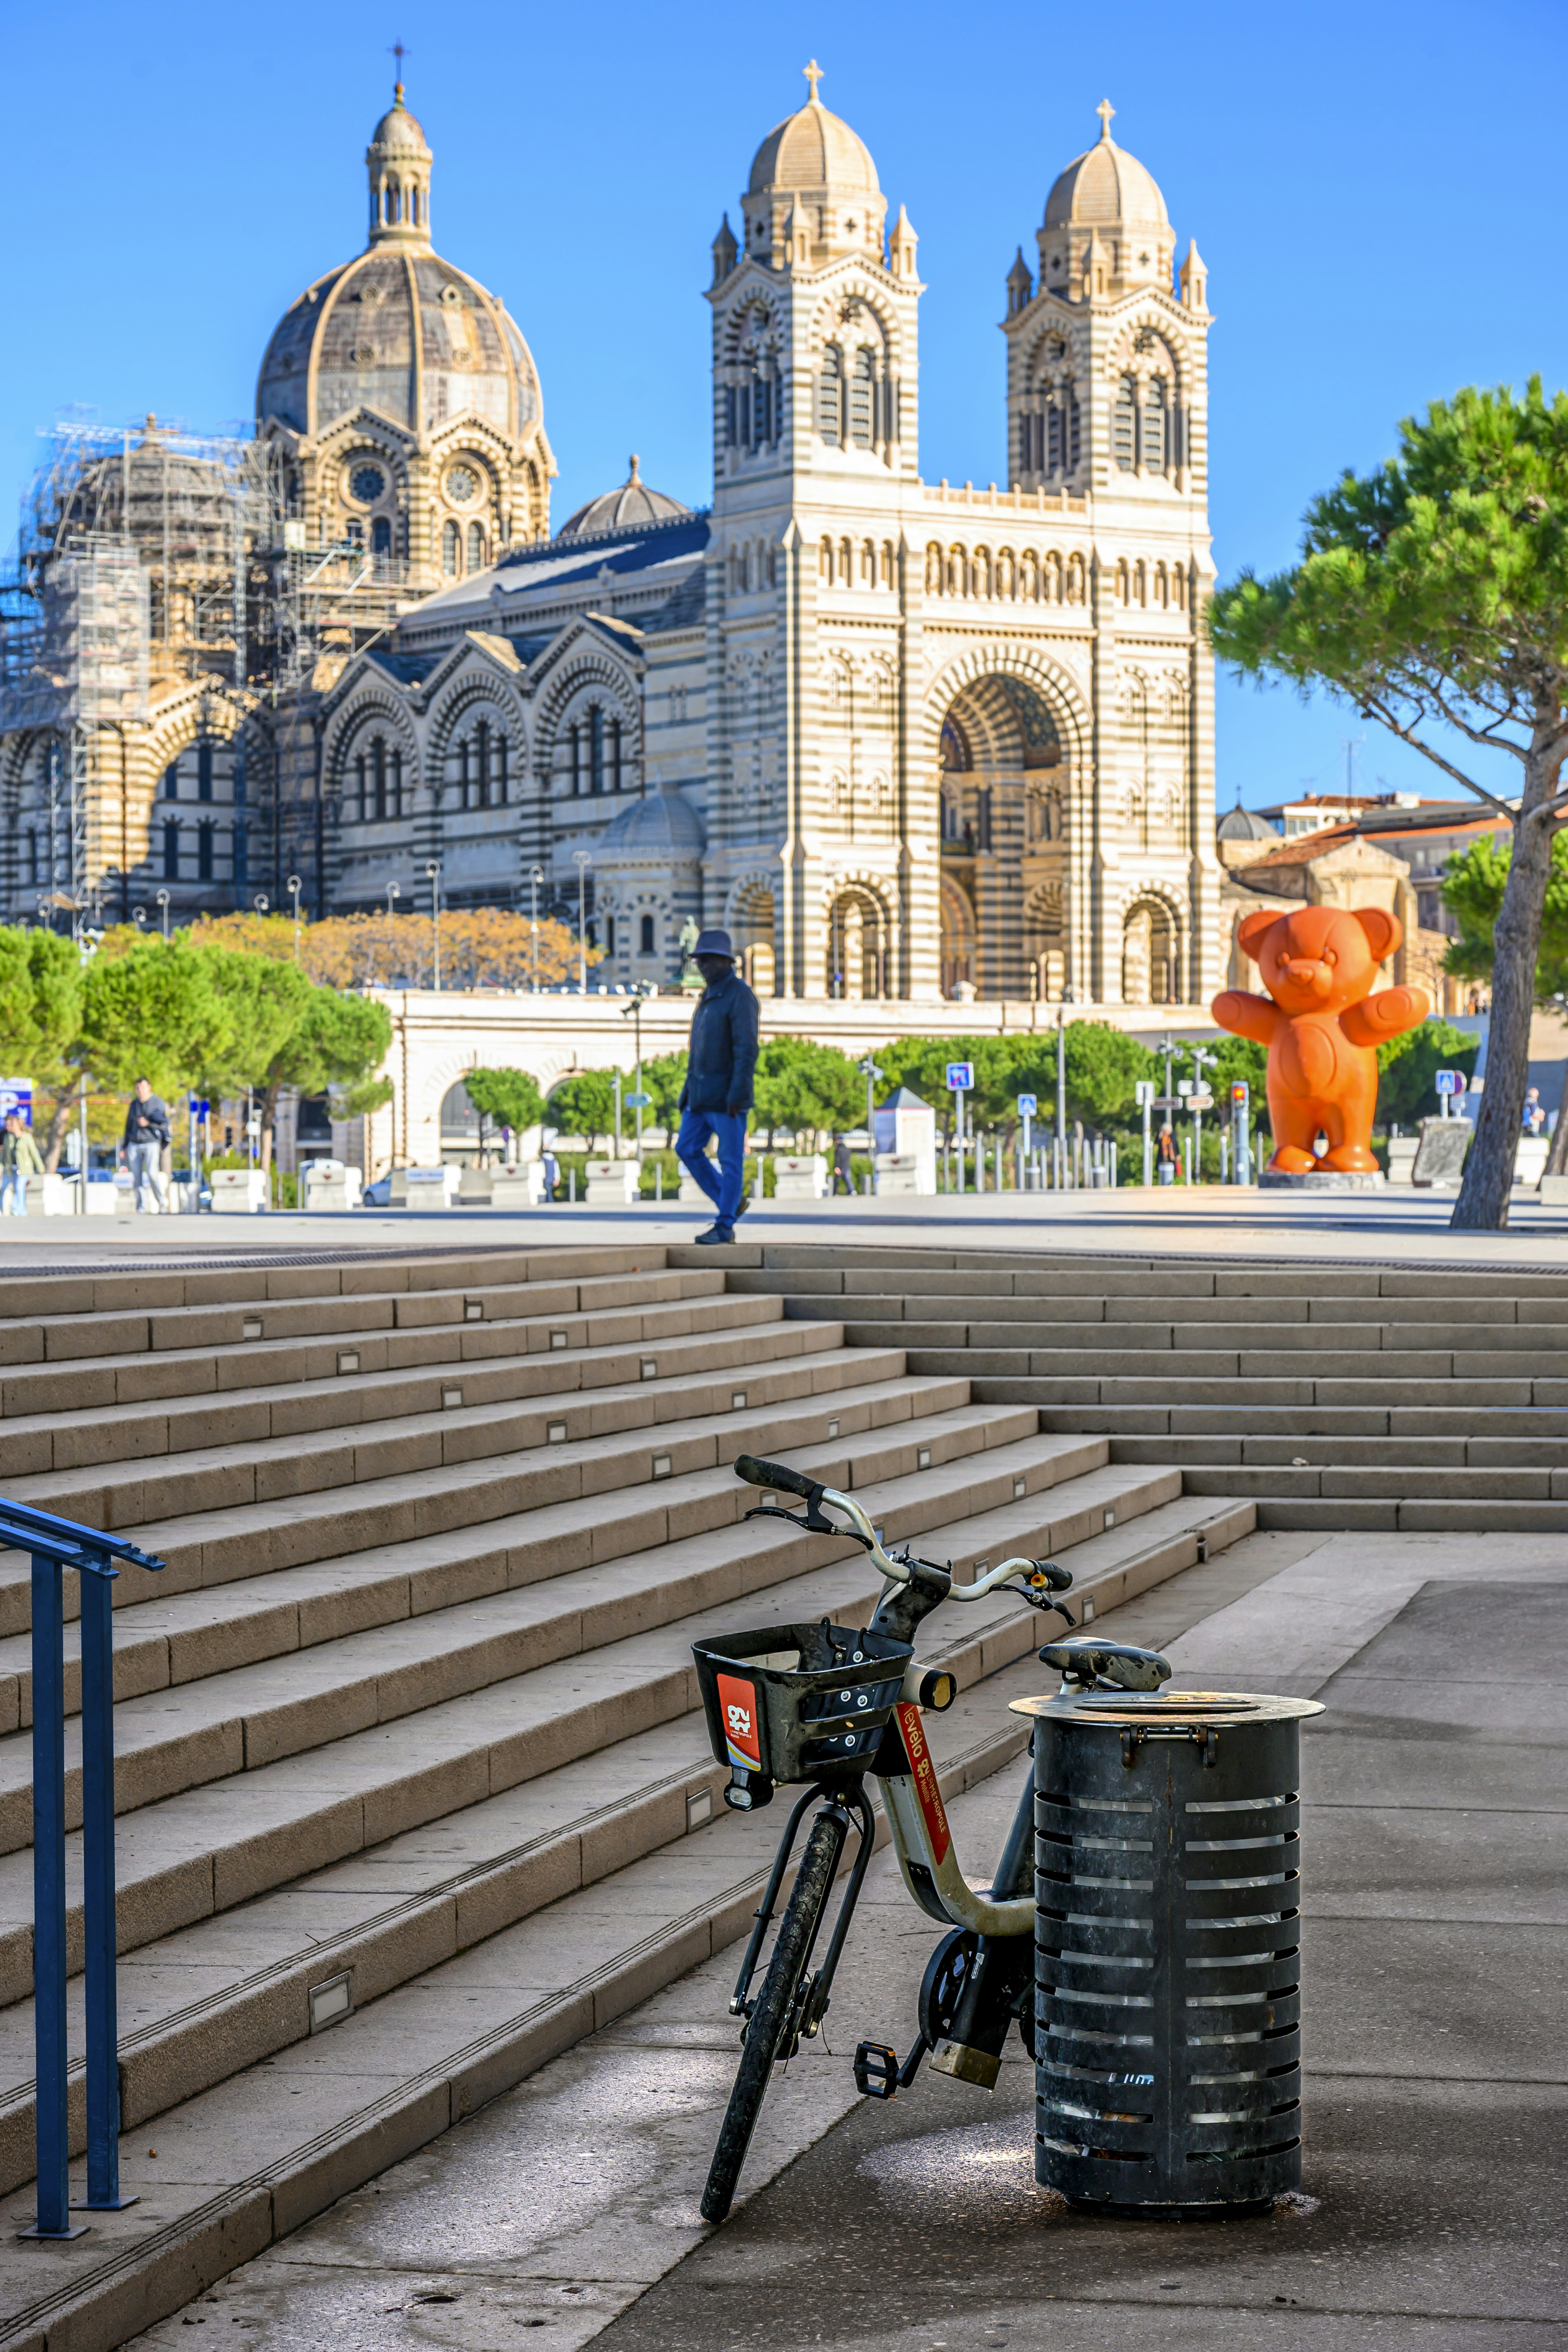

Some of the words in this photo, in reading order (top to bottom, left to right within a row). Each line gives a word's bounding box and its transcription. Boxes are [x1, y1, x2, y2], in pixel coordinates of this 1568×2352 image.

[0, 1092, 19, 1118] P
[904, 1705, 923, 1757] levélo
[920, 1778, 931, 1804] Mobilité
